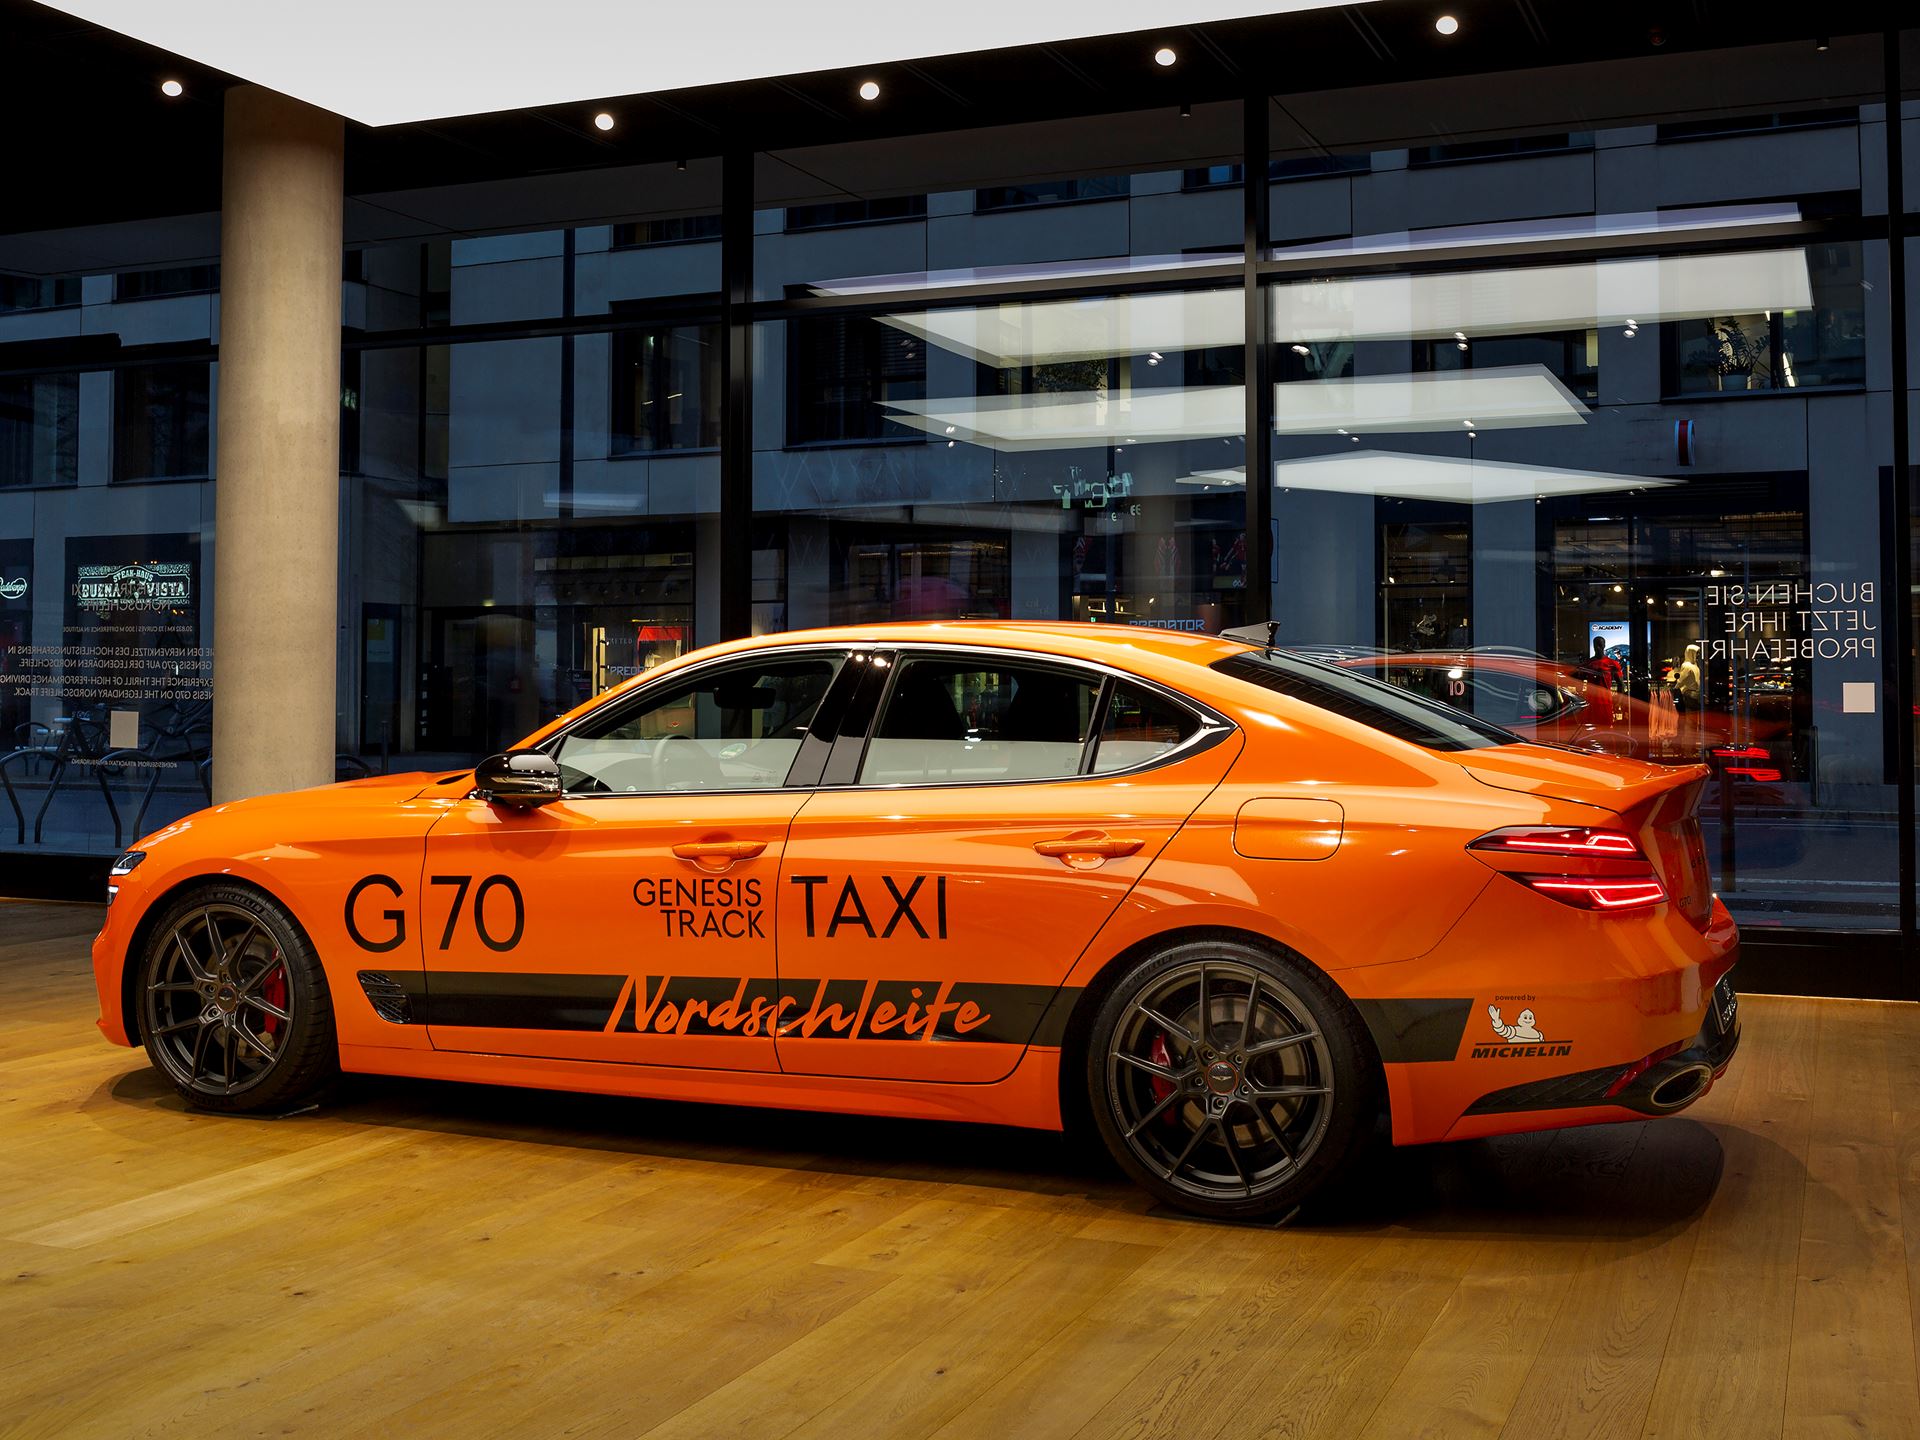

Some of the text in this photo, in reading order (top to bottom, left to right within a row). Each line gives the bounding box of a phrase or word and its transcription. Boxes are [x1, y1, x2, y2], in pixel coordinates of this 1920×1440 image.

[81, 583, 121, 598] BUENA
[146, 581, 185, 598] VISTA
[1447, 681, 1465, 696] 10
[633, 878, 762, 907] GENESIS
[790, 874, 948, 940] TAXI
[344, 873, 525, 953] G70
[660, 909, 766, 939] TRACK
[605, 975, 991, 1042] Nordschleife
[1527, 994, 1536, 1002] by
[1471, 1045, 1572, 1059] MICHELIN
